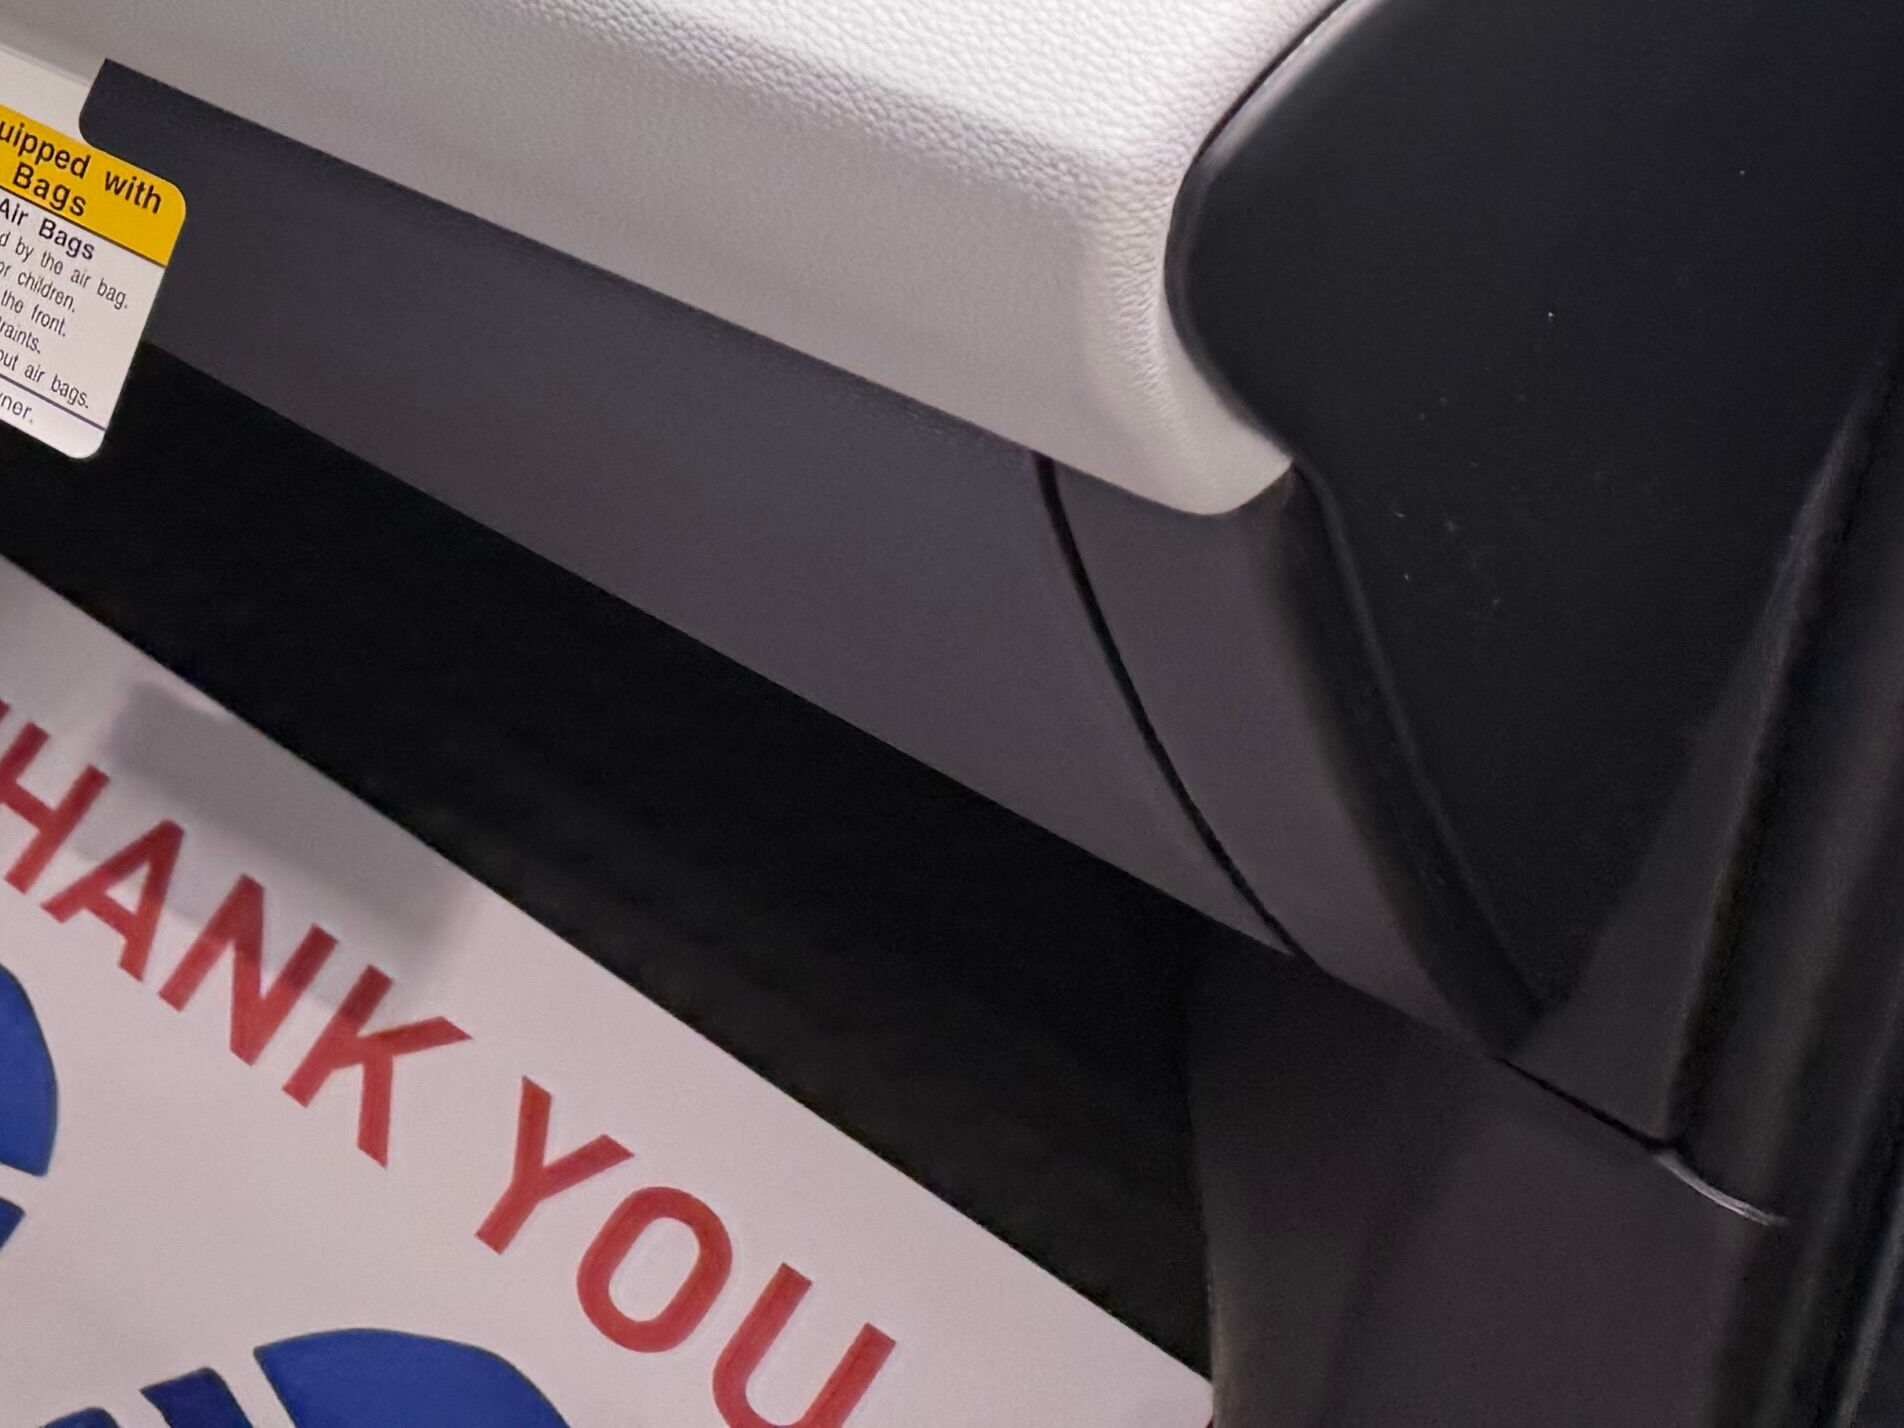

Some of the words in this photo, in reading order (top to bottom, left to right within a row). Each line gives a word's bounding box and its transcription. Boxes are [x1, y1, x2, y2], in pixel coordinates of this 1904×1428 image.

[10, 159, 87, 217] Bags
[103, 169, 162, 215] with
[37, 215, 95, 261] Bags
[13, 235, 35, 263] by
[39, 249, 64, 276] the
[69, 268, 91, 288] air
[96, 277, 128, 310] bag.
[16, 270, 75, 313] children.
[0, 288, 24, 314] the
[30, 303, 66, 337] front.
[23, 363, 46, 383] air
[49, 373, 89, 409] bags.
[475, 1075, 897, 1428] YOU
